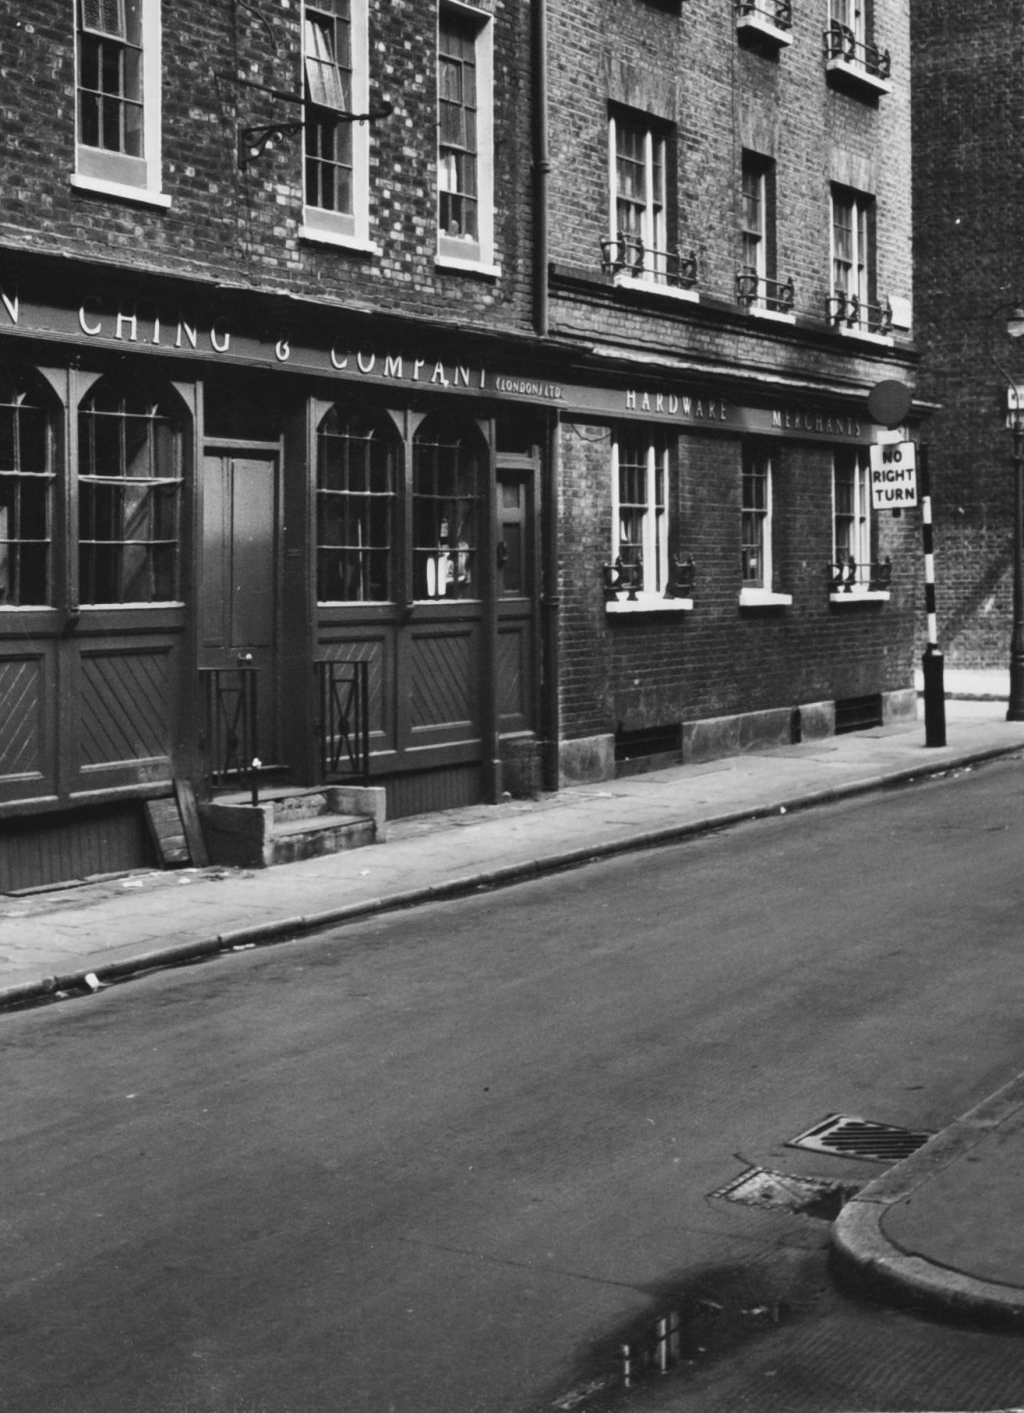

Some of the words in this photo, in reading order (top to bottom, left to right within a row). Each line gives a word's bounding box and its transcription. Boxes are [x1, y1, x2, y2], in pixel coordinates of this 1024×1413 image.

[78, 296, 230, 353] CHING
[495, 376, 543, 396] (LONDON)
[625, 389, 727, 420] HARDWARE
[772, 409, 862, 437] MERCHANTS
[882, 450, 903, 464] NO
[873, 468, 914, 483] RIGHT
[875, 487, 915, 502] TURN
